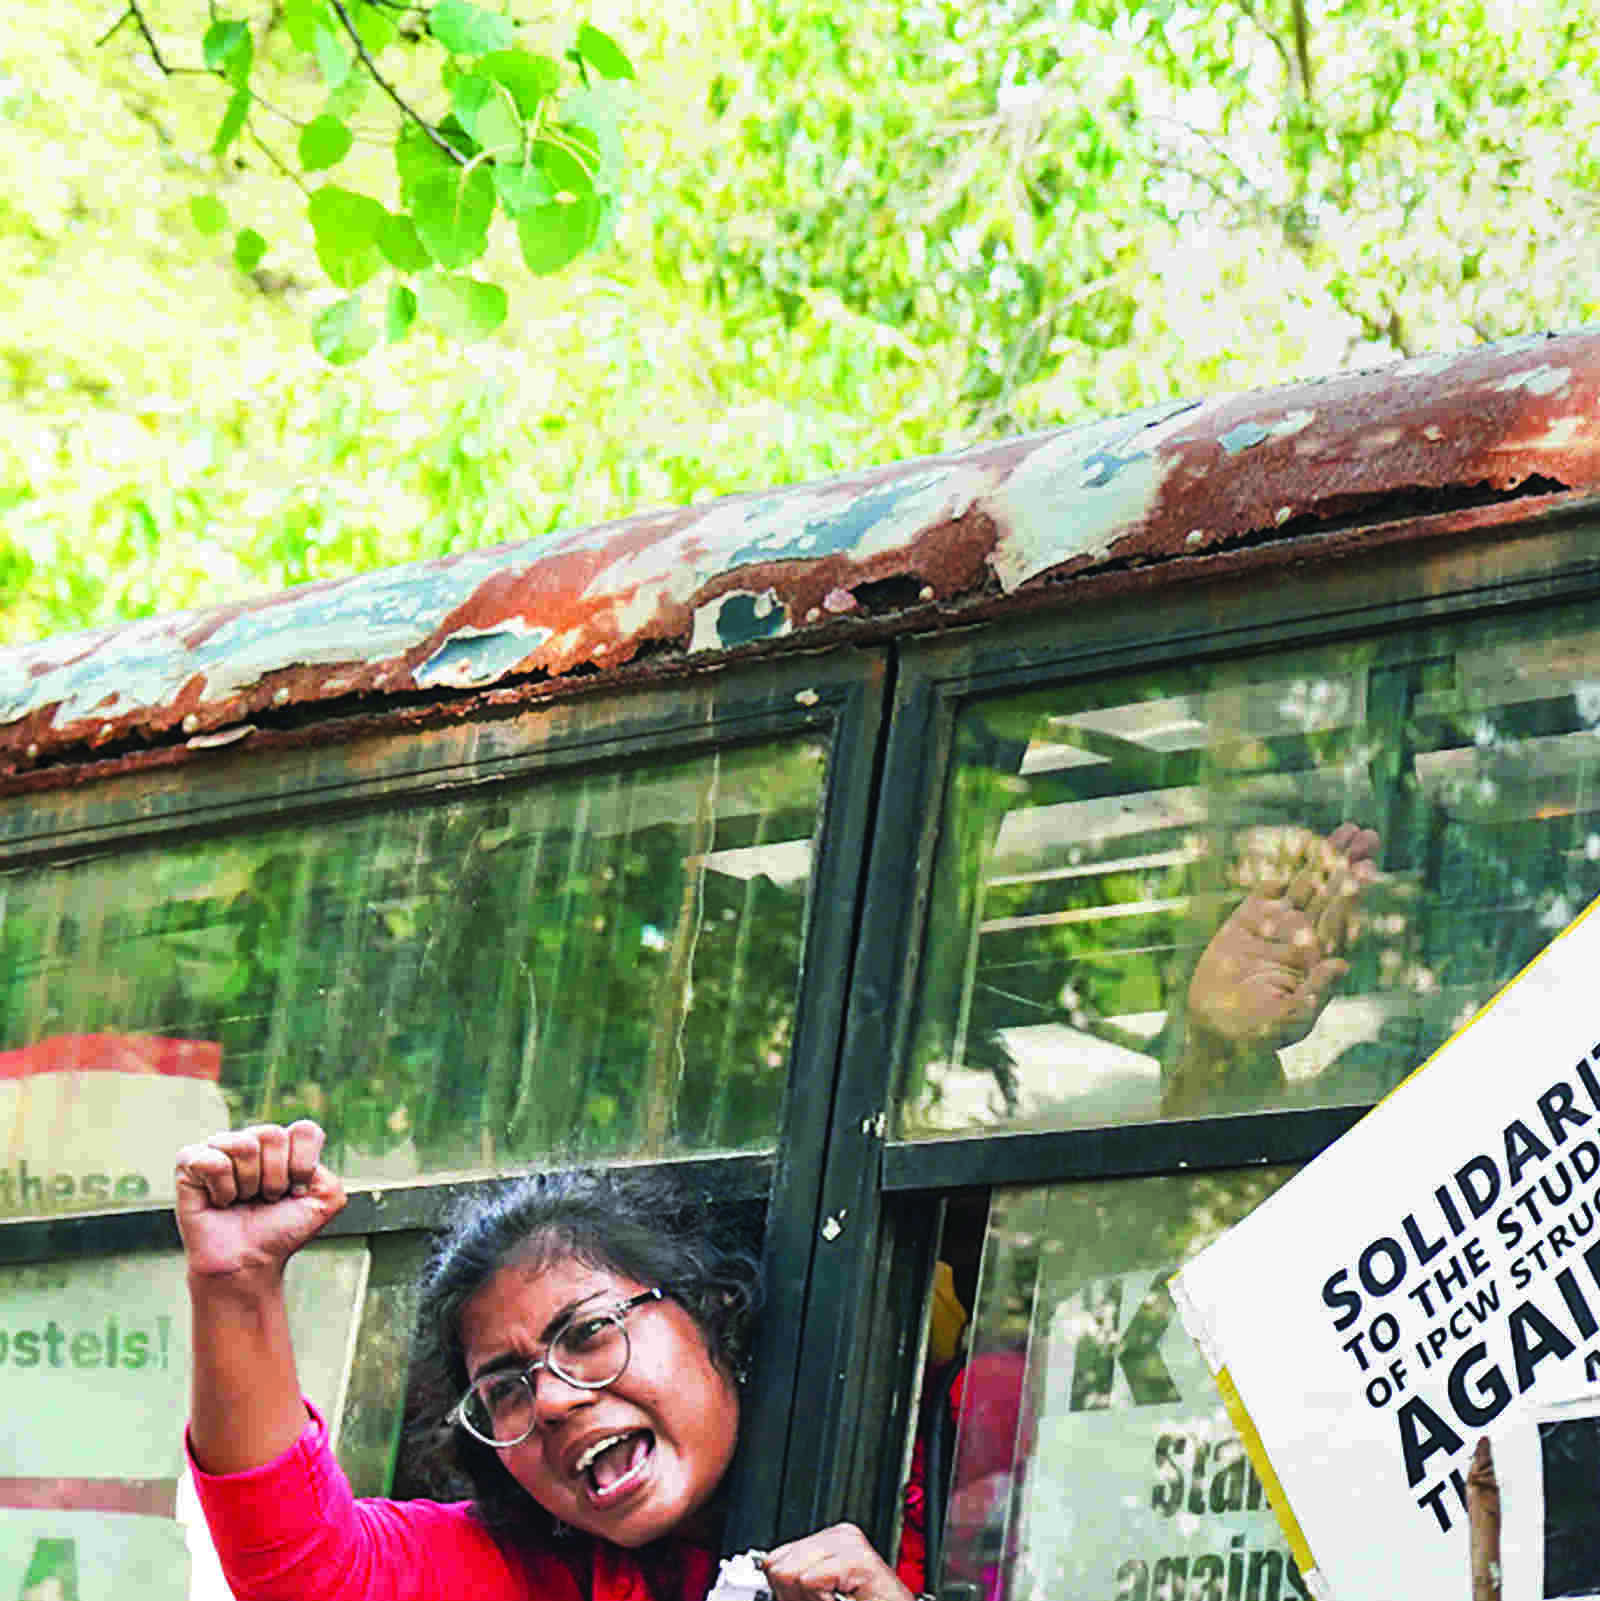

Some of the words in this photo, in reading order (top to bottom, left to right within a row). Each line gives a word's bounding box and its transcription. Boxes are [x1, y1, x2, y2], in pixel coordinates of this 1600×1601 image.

[1342, 1312, 1401, 1371] TO
[1408, 1238, 1492, 1319] THE
[1366, 1359, 1409, 1408] OF
[1415, 1280, 1501, 1368] IPCW
[1151, 1434, 1273, 1517] Sta
